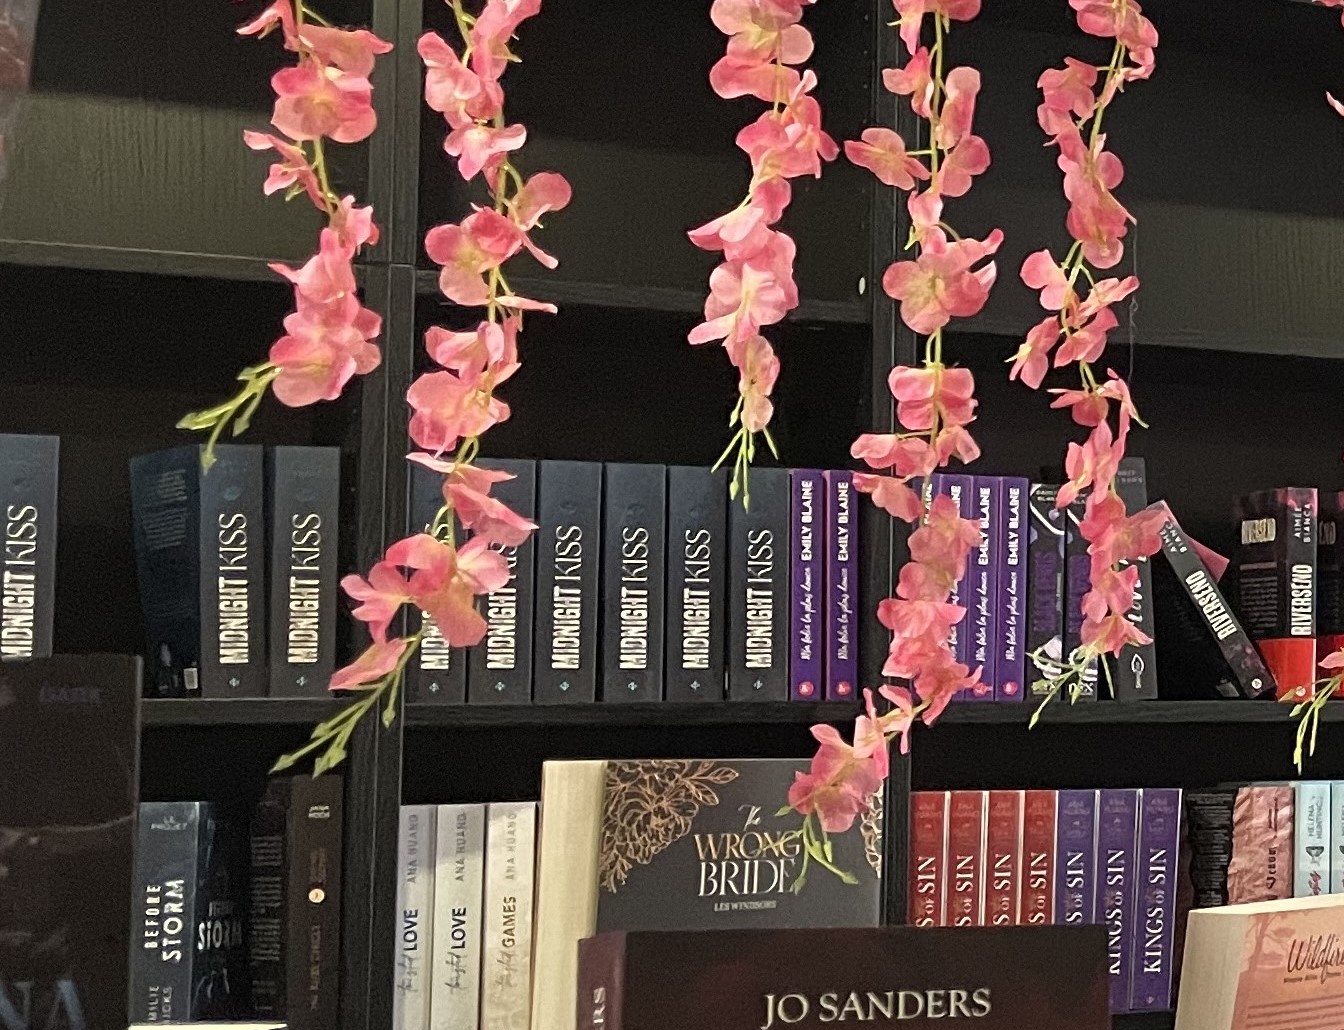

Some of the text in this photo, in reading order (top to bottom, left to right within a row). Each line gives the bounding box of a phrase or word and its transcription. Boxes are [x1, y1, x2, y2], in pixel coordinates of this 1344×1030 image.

[801, 480, 813, 561] EMILY BLAINE
[838, 482, 849, 561] EMILY BLAINE
[1008, 487, 1019, 565] EMILY BLAINE
[1, 505, 38, 657] MIDNIGHT KISS
[219, 513, 249, 664] MIDNIGHT KISS
[288, 513, 321, 663] MIDNIGHT KISS
[552, 525, 582, 669] MIDNIGHT KISS
[619, 527, 648, 669] MIDNIGHT KISS
[682, 529, 711, 668] MIDNIGHT KISS
[745, 529, 773, 668] MIDNIGHT KISS
[1186, 571, 1237, 640] RIVERSEND
[1291, 564, 1313, 635] RIVERSEND
[487, 586, 516, 669] MIDNIGHT
[407, 859, 417, 883] ANA
[455, 858, 464, 881] ANA
[694, 830, 800, 860] WRONG
[698, 858, 797, 896] BRIDE
[918, 856, 936, 894] SIN
[956, 855, 973, 892] SIN
[994, 854, 1011, 890] SIN
[1030, 852, 1047, 889] SIN
[1067, 851, 1084, 889] SIN
[1107, 849, 1124, 886] SIN
[145, 885, 161, 949] BEFORE
[162, 880, 185, 962] STORM
[404, 909, 418, 950] LOVE
[452, 908, 466, 949] LOVE
[502, 897, 516, 949] GAMES
[1144, 848, 1166, 974] KINGS SIN
[761, 988, 992, 1030] JO SANDERS
